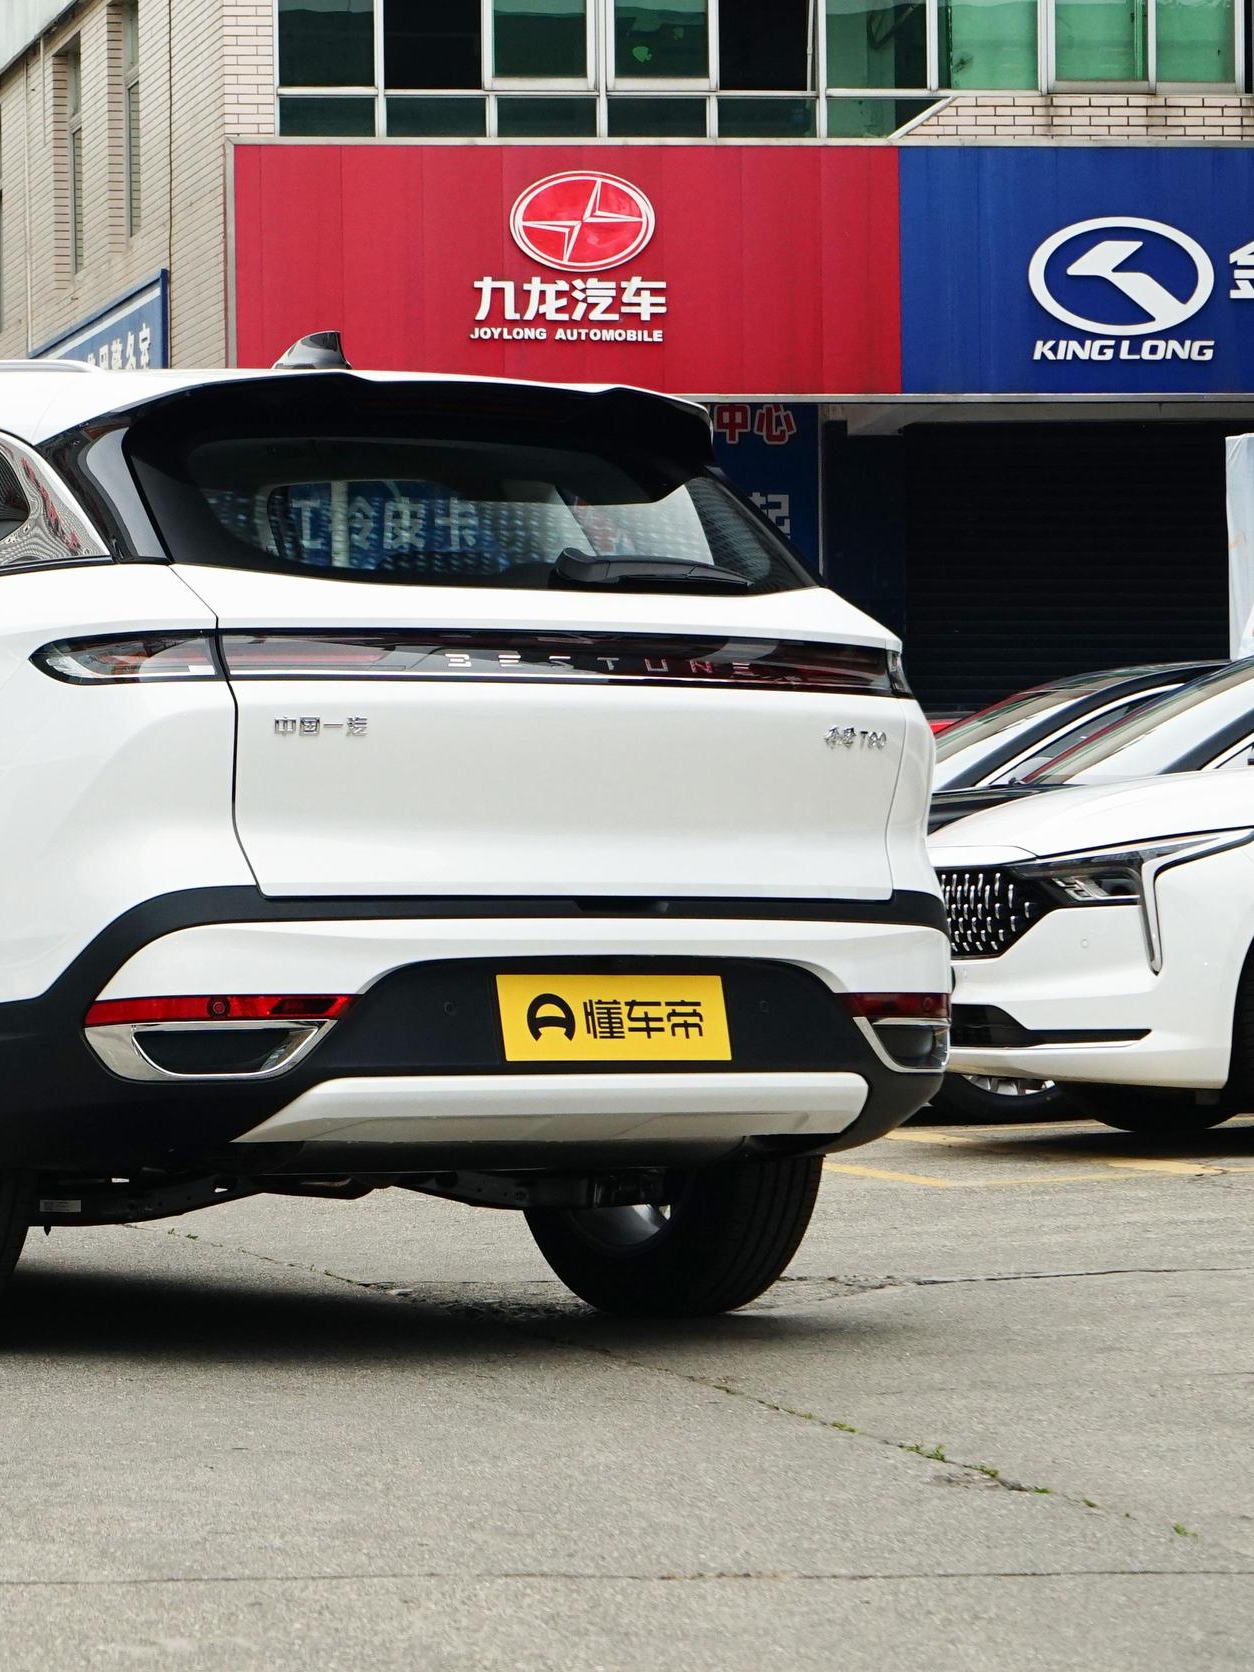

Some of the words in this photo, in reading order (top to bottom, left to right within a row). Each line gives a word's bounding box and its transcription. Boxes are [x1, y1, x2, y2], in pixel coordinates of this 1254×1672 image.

[473, 276, 668, 322] 九龙汽车
[87, 322, 151, 370] 警务室
[469, 327, 547, 341] JOYLONG
[554, 327, 664, 343] AUTOMOBILE
[1032, 339, 1116, 361] KING
[1118, 339, 1216, 361] LONG
[714, 403, 797, 445] 中心
[444, 652, 754, 677] BESTUNE
[273, 715, 368, 737] 中国一汽
[582, 998, 704, 1040] 懂车帝
